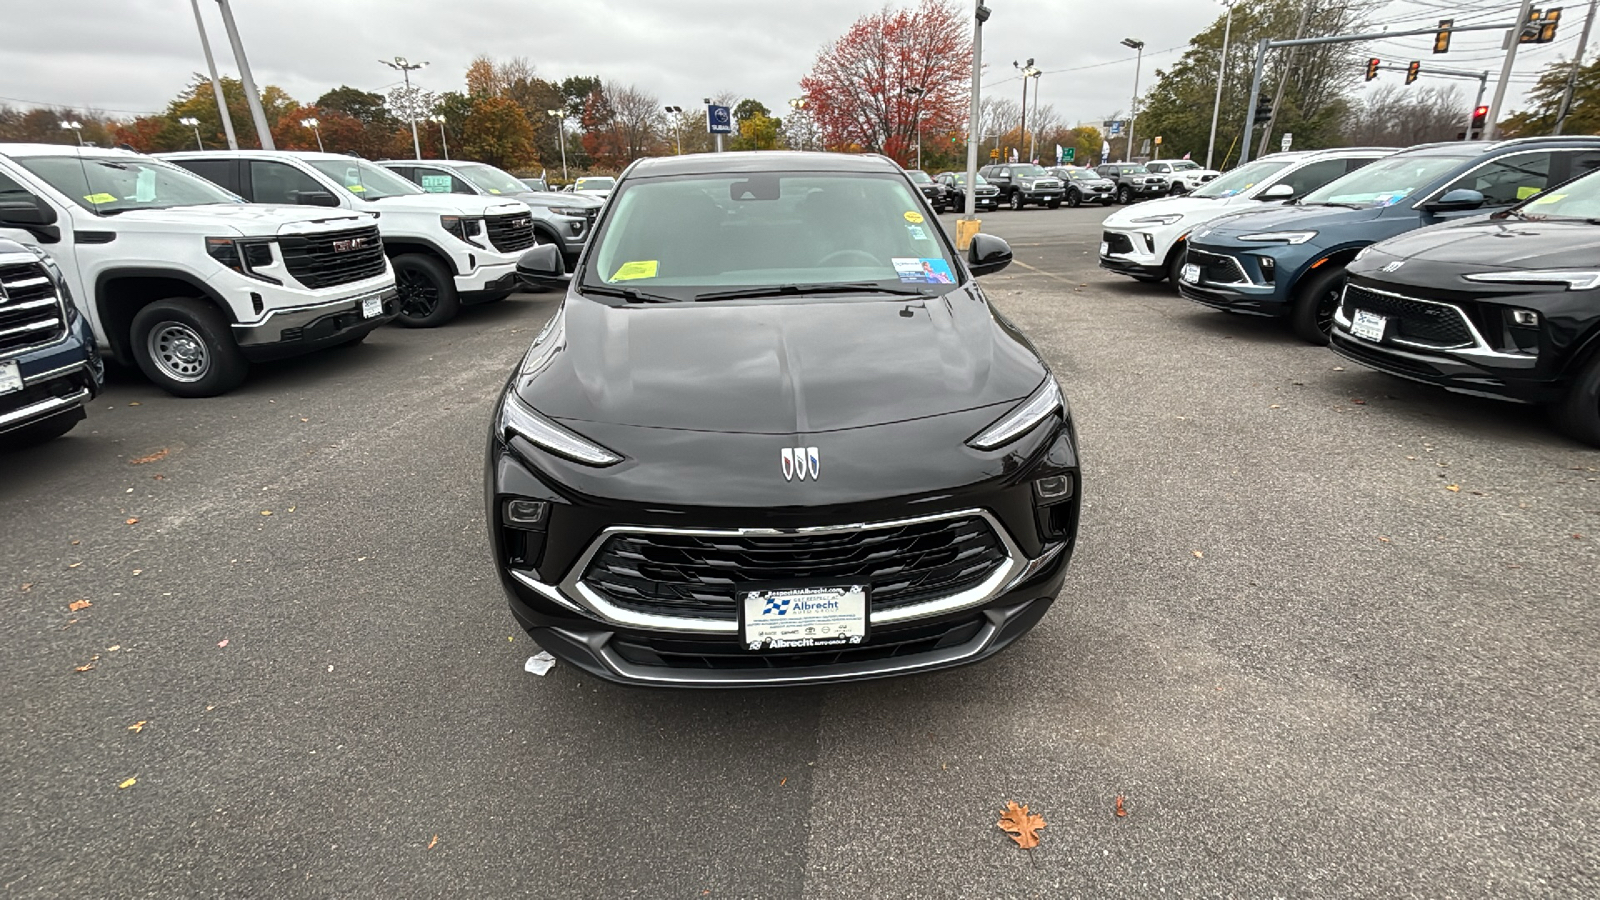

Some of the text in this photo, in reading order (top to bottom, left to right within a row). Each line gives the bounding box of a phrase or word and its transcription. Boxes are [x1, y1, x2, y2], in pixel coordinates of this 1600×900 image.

[333, 237, 368, 253] GMC
[792, 600, 839, 611] Albrecht
[769, 638, 814, 649] Albrecht
